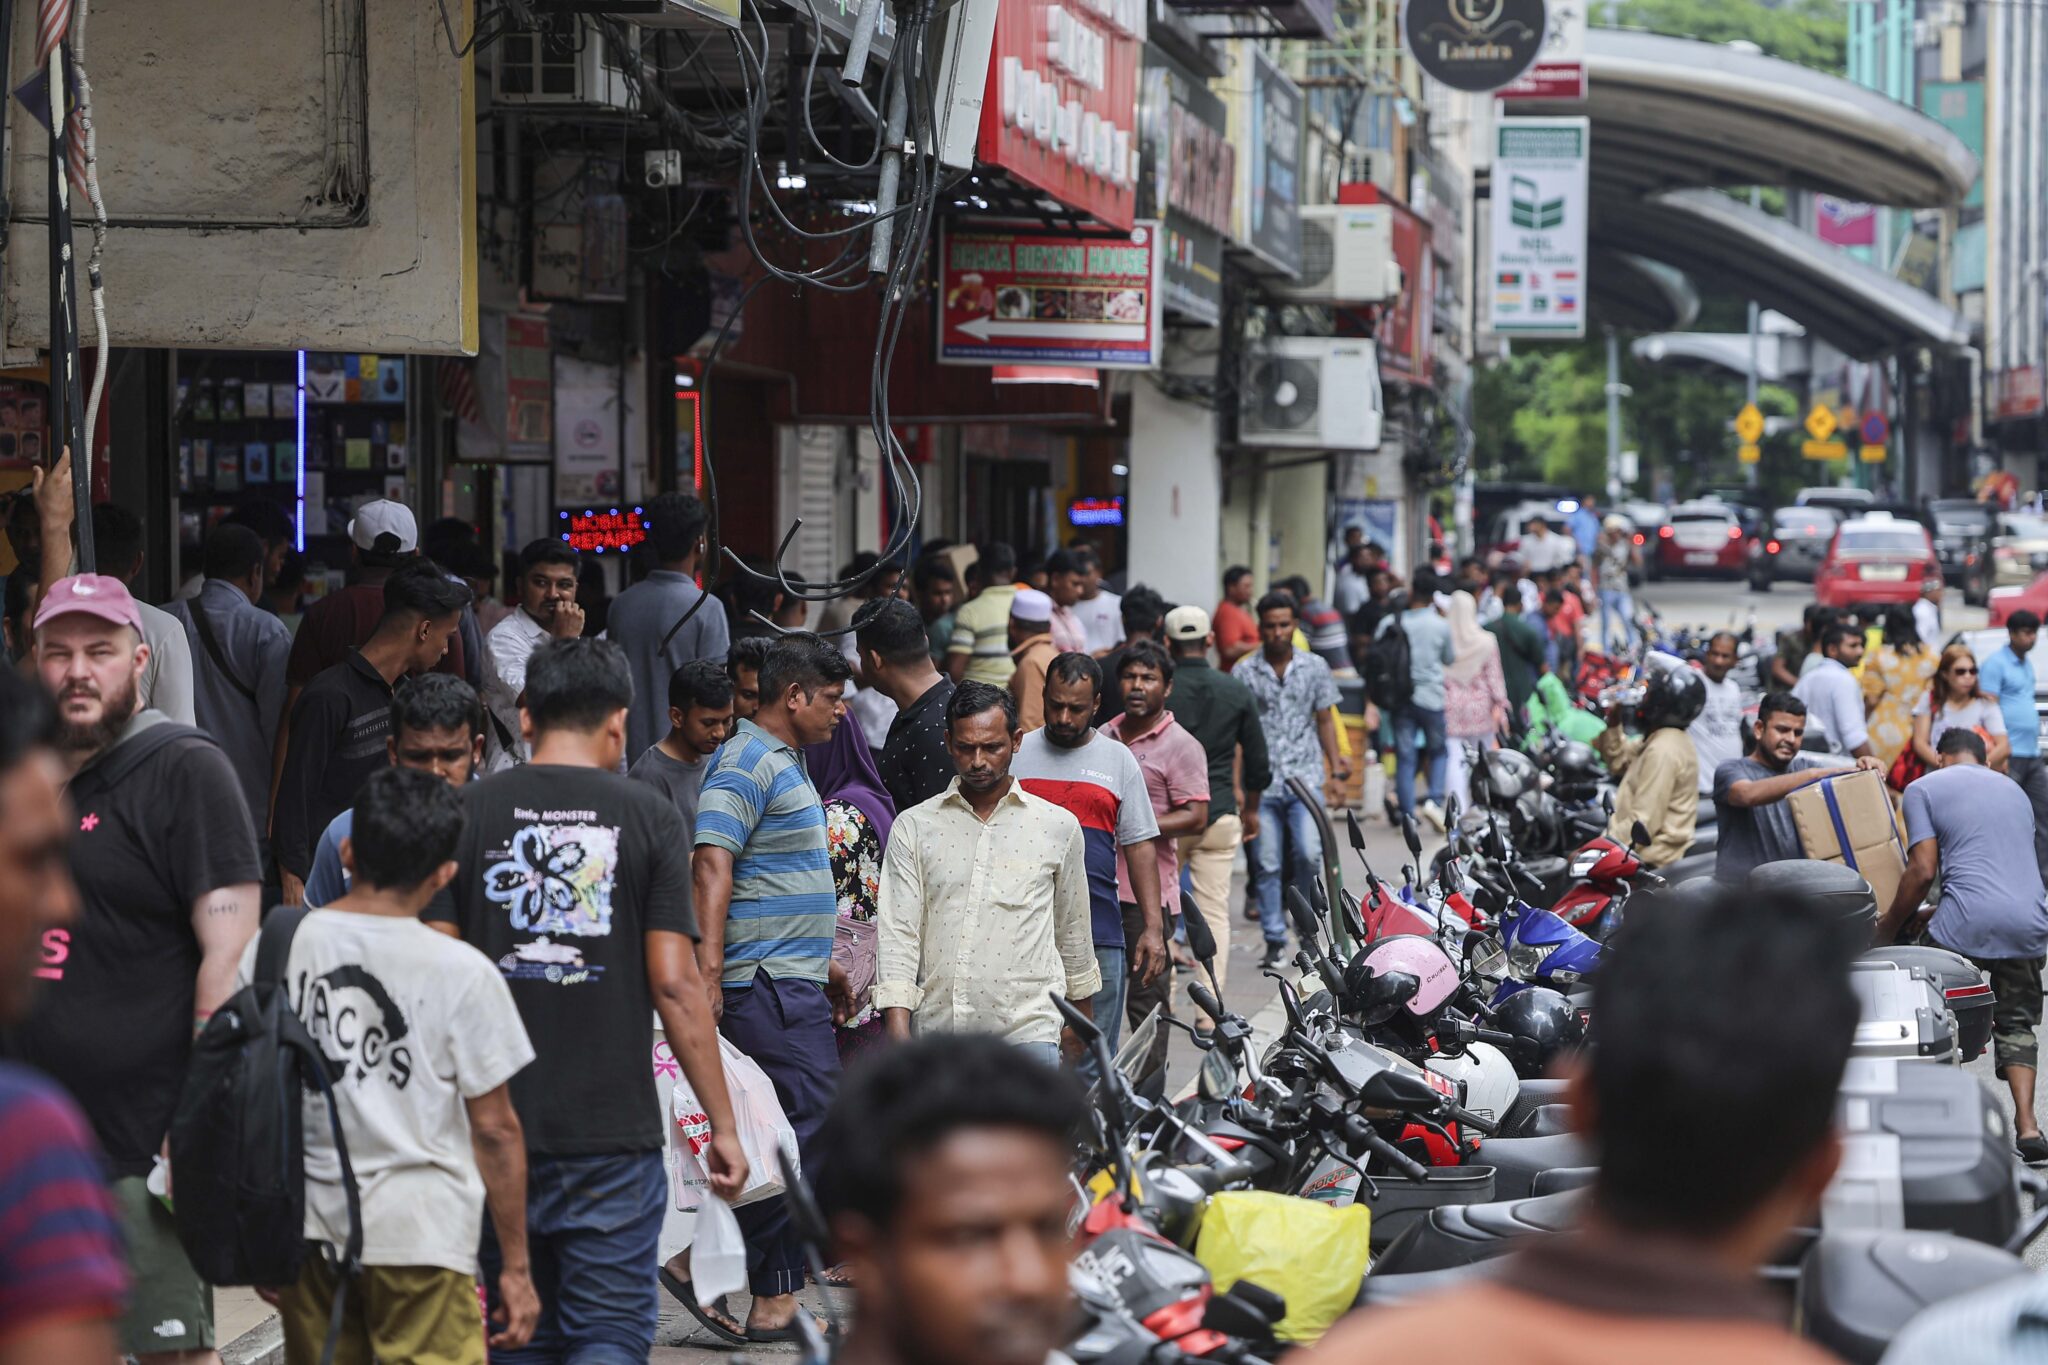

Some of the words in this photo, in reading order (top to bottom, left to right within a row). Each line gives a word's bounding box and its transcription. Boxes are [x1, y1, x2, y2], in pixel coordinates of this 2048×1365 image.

[952, 243, 1011, 272] DHAKA
[1015, 245, 1084, 274] BIRYANI
[1087, 246, 1149, 276] HOUSE
[571, 512, 641, 532] MOBILE
[541, 809, 597, 821] MONSTER
